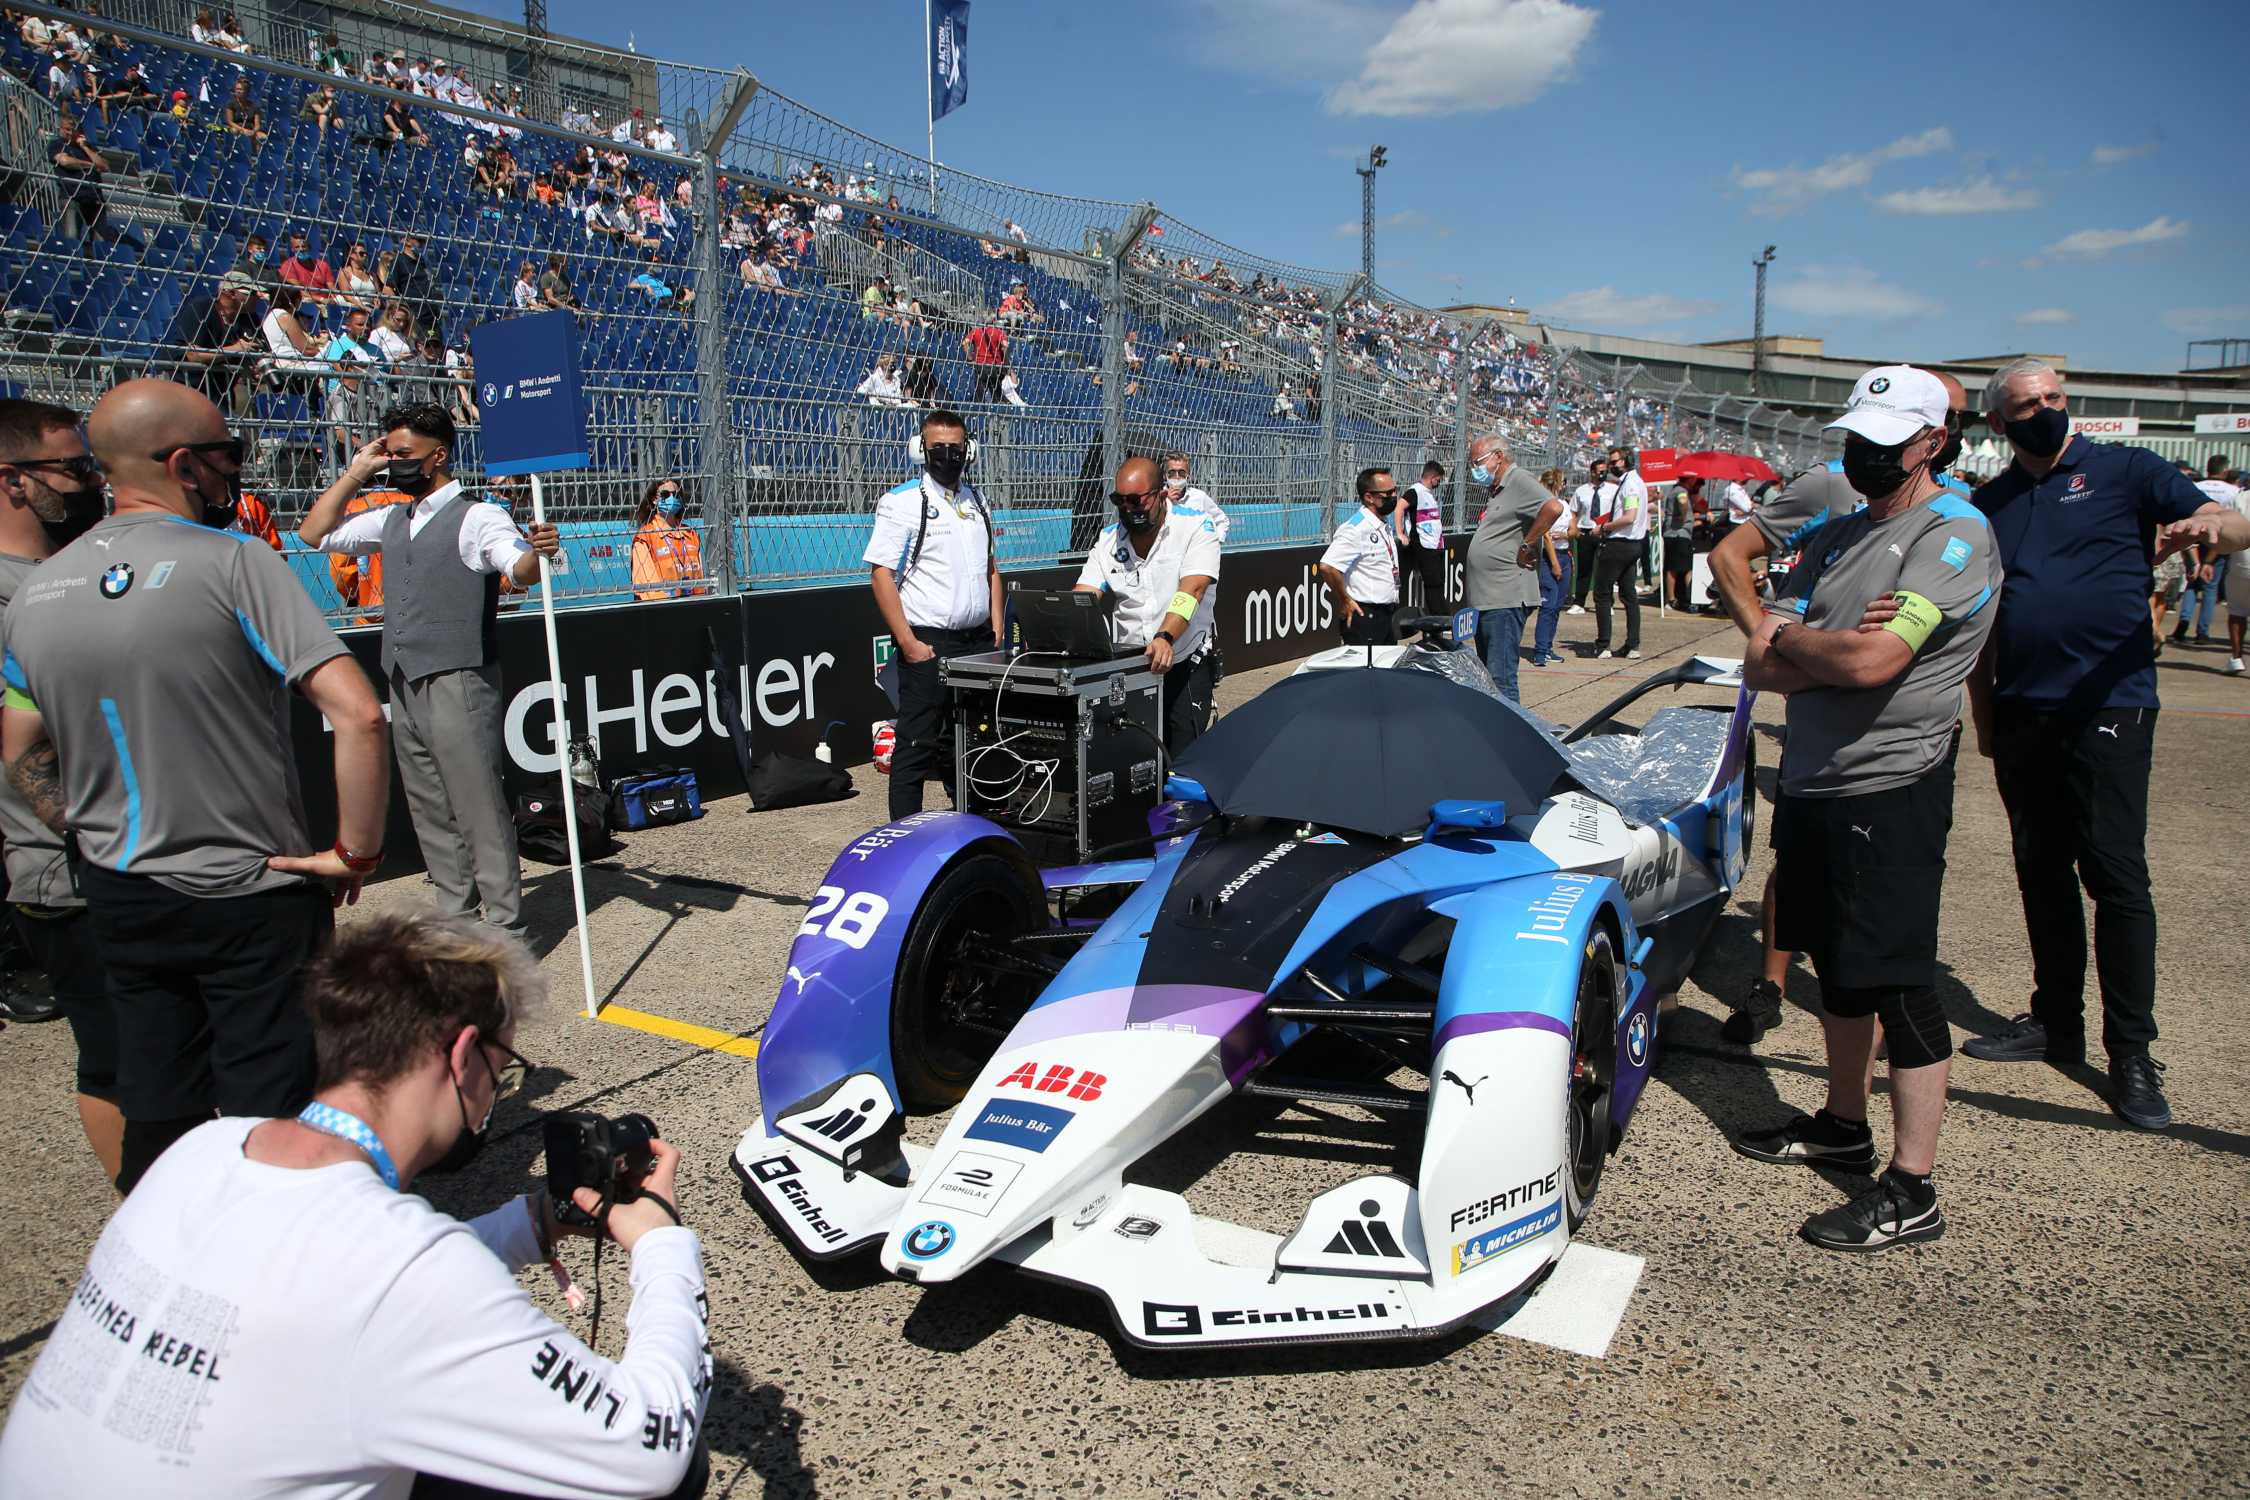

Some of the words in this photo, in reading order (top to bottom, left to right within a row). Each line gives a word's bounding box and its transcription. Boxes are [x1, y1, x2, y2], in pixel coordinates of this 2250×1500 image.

[938, 26, 946, 61] ACTION
[520, 380, 534, 388] BMW
[538, 374, 561, 385] Andretti
[521, 388, 552, 399] Motorsport
[1862, 399, 1896, 411] Motorsport
[2074, 422, 2123, 433] BOSCH
[590, 546, 613, 557] ABB
[1769, 563, 1790, 574] 33
[52, 576, 88, 588] Andretti
[1246, 564, 1333, 644] modis
[1013, 622, 1021, 643] BMW
[1458, 612, 1474, 638] GUE
[849, 828, 914, 862] Bär
[1263, 842, 1297, 861] BMW
[797, 885, 889, 950] 28
[1515, 883, 1586, 946] Julius
[996, 1062, 1108, 1102] ABB
[983, 1112, 1024, 1129] Julius
[1025, 1119, 1053, 1135] Bär
[940, 1183, 982, 1199] FORMULA
[1088, 1195, 1106, 1210] ACTION
[1450, 1162, 1563, 1233] FORTINET
[776, 1178, 849, 1244] Einhell
[1485, 1210, 1558, 1254] MICHELIN
[1211, 1303, 1389, 1327] Einhell
[142, 1330, 221, 1382] REBEL
[531, 1341, 630, 1433] LINE
